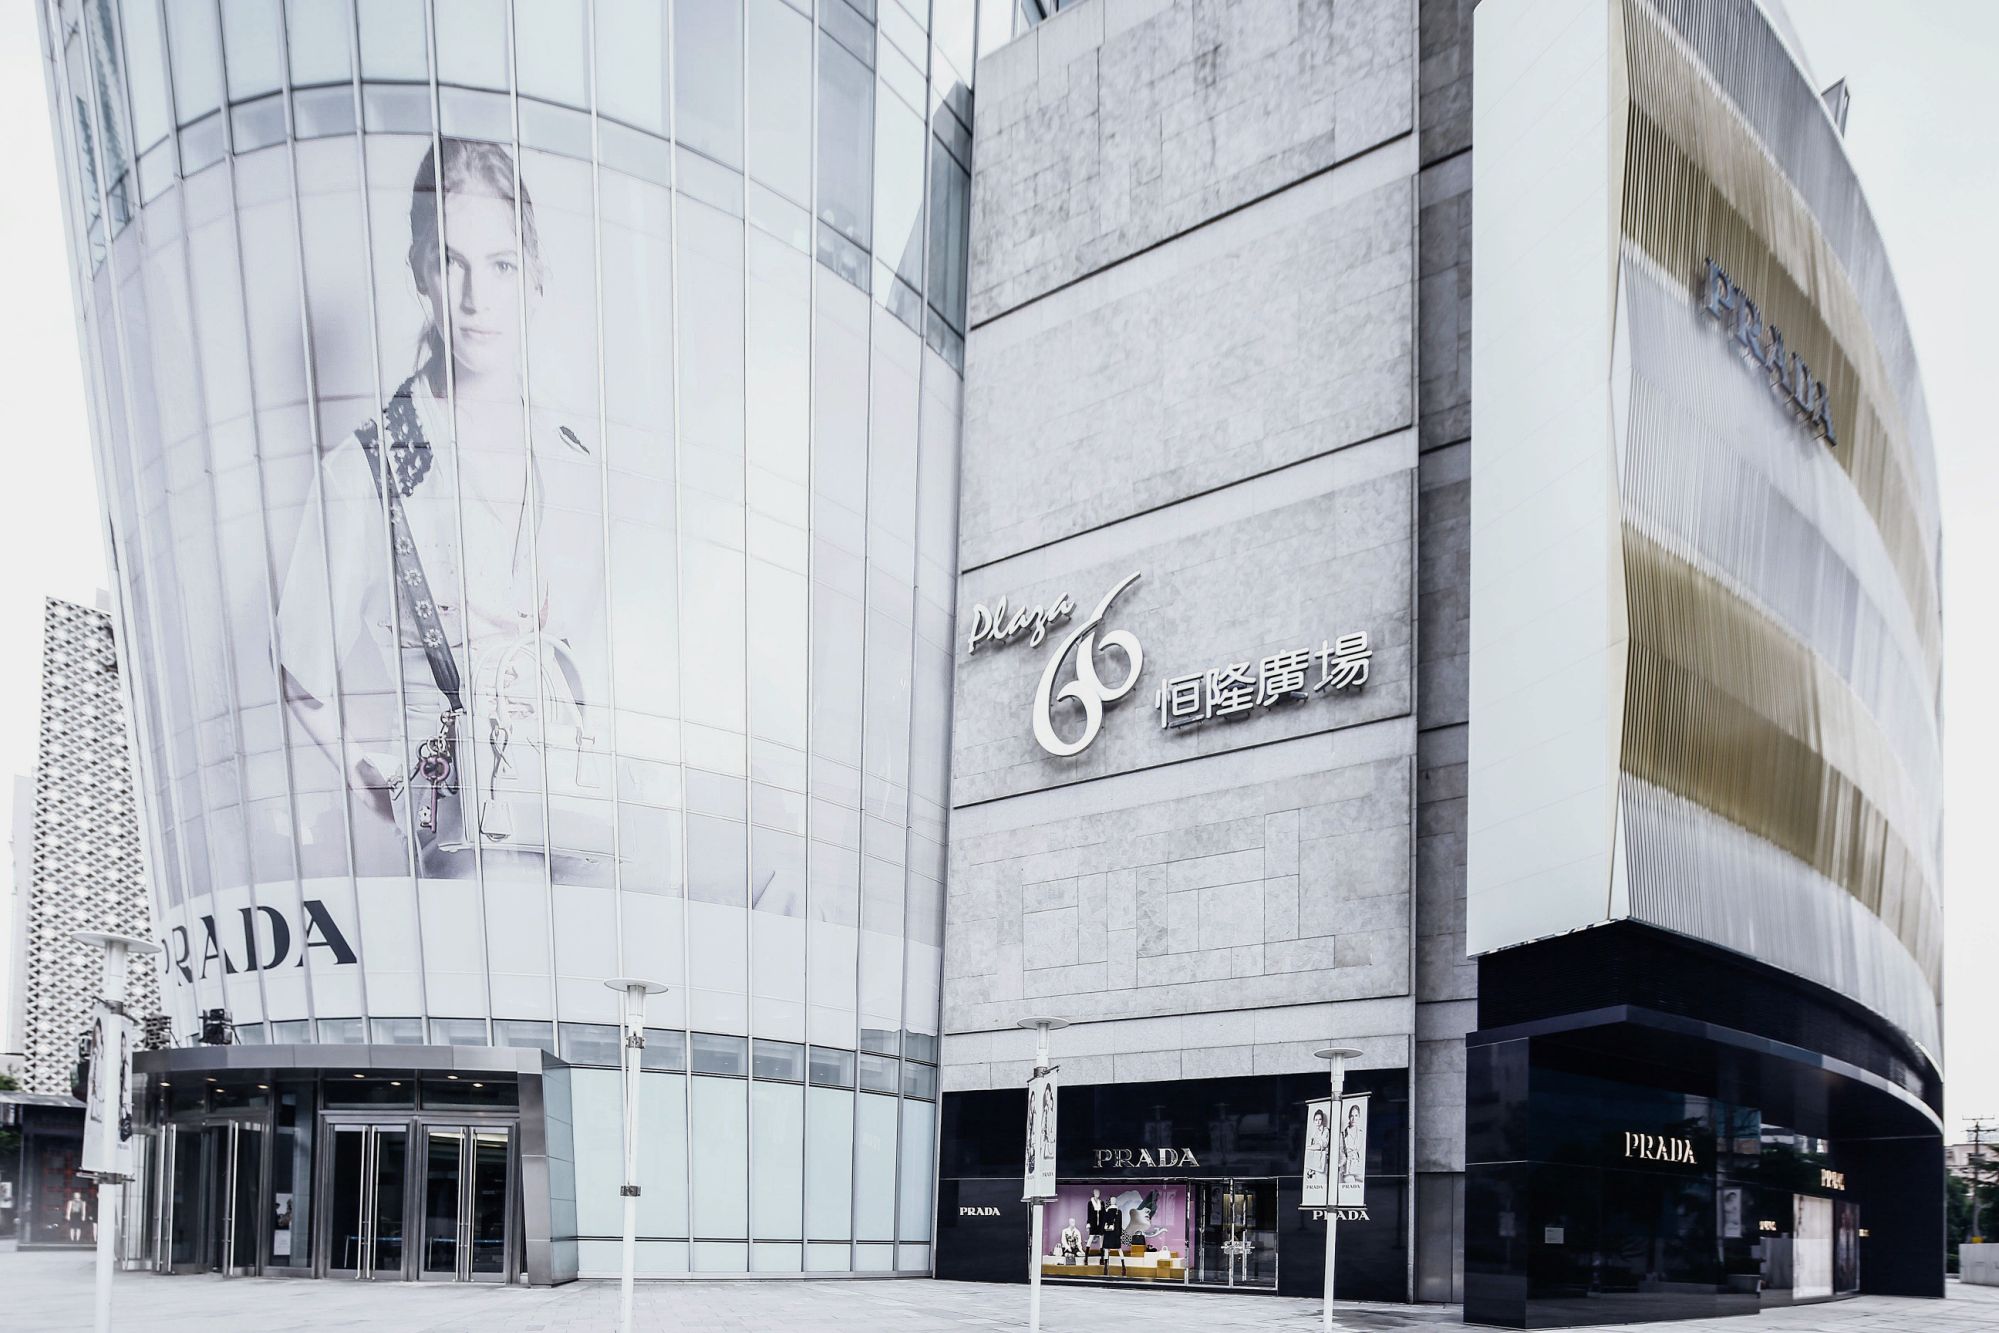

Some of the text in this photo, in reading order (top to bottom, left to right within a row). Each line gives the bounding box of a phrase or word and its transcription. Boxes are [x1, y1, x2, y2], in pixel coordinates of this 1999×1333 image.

[1705, 257, 1837, 447] PRADA
[968, 570, 1144, 757] Plaza 66
[1155, 631, 1373, 729] 恒隆廣場
[1093, 1148, 1200, 1168] PRADA
[1624, 1131, 1698, 1165] PRADA
[959, 1206, 1001, 1216] PRADA
